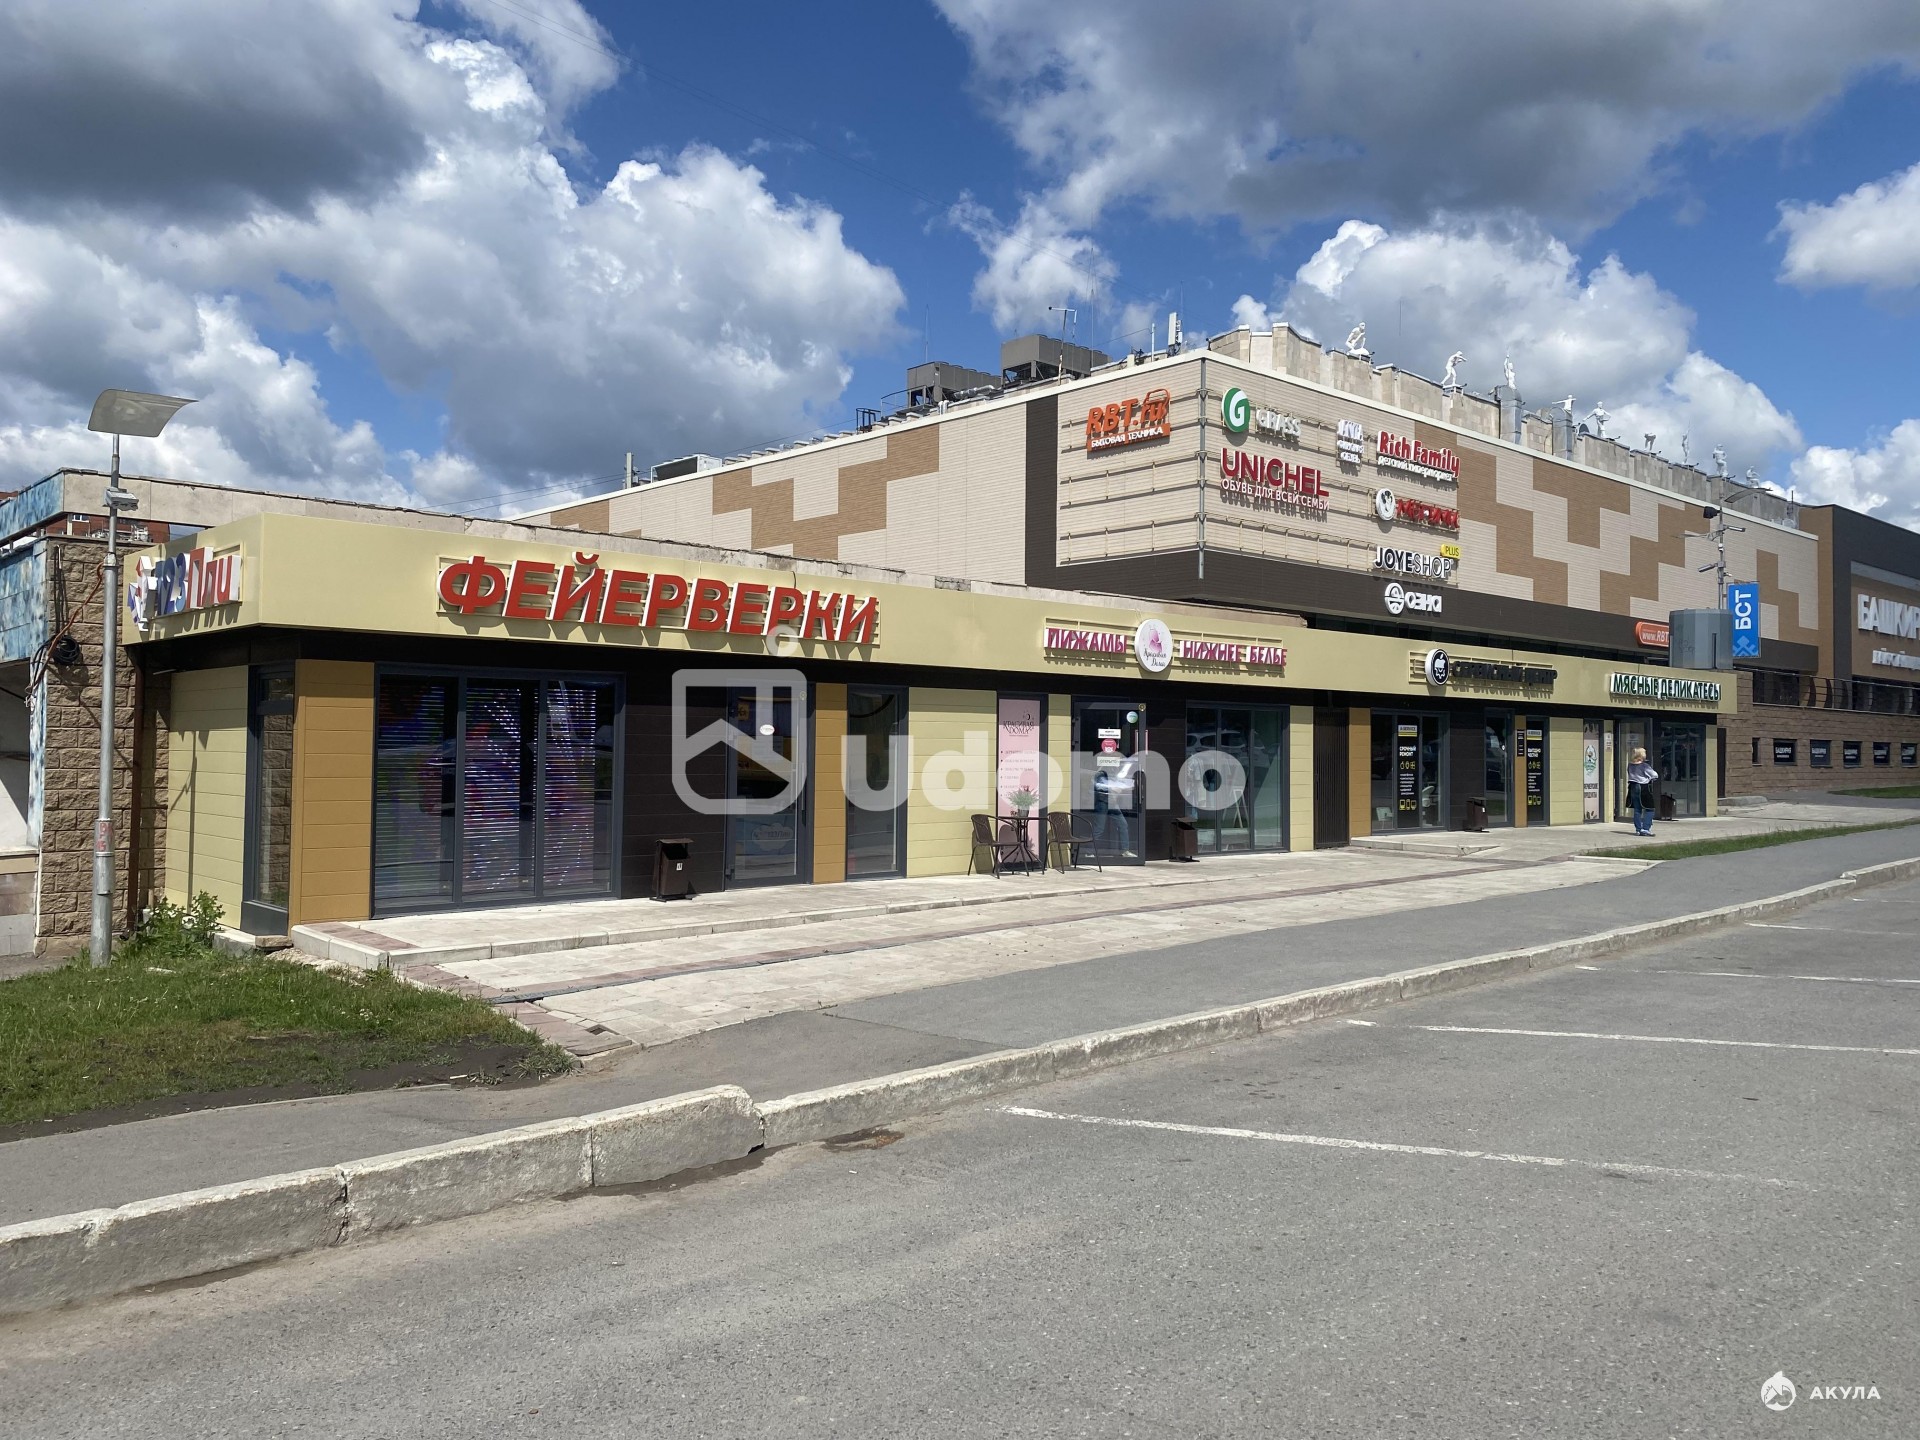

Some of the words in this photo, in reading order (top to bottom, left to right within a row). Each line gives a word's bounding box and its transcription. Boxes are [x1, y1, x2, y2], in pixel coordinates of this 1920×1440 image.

[1086, 398, 1168, 435] RBT.ru
[1256, 409, 1301, 437] GRASS
[1091, 434, 1126, 448] БЫТОВАЯ
[1128, 427, 1163, 440] ТЕХНИКА
[1377, 430, 1411, 460] Rich
[1411, 440, 1460, 478] Family
[1221, 447, 1330, 497] UNICHEL
[1221, 478, 1253, 495] ОБУВЬ
[1255, 485, 1273, 498] ДЛЯ
[1275, 490, 1299, 505] ВСЕЙ
[1300, 495, 1330, 510] СЕМЬИ
[1373, 545, 1452, 579] JOYESHOP
[1445, 545, 1460, 557] PLUS
[437, 551, 879, 644] ФЕЙЕРВЕРКИ
[1735, 589, 1752, 631] БСТ
[1043, 627, 1127, 654] ПИЖАМЫ
[1180, 640, 1243, 663] НИЖНЕЕ
[1610, 672, 1659, 697] МЯСНЫЕ
[1658, 677, 1722, 701] ДЕЛИКАТЕСЫ
